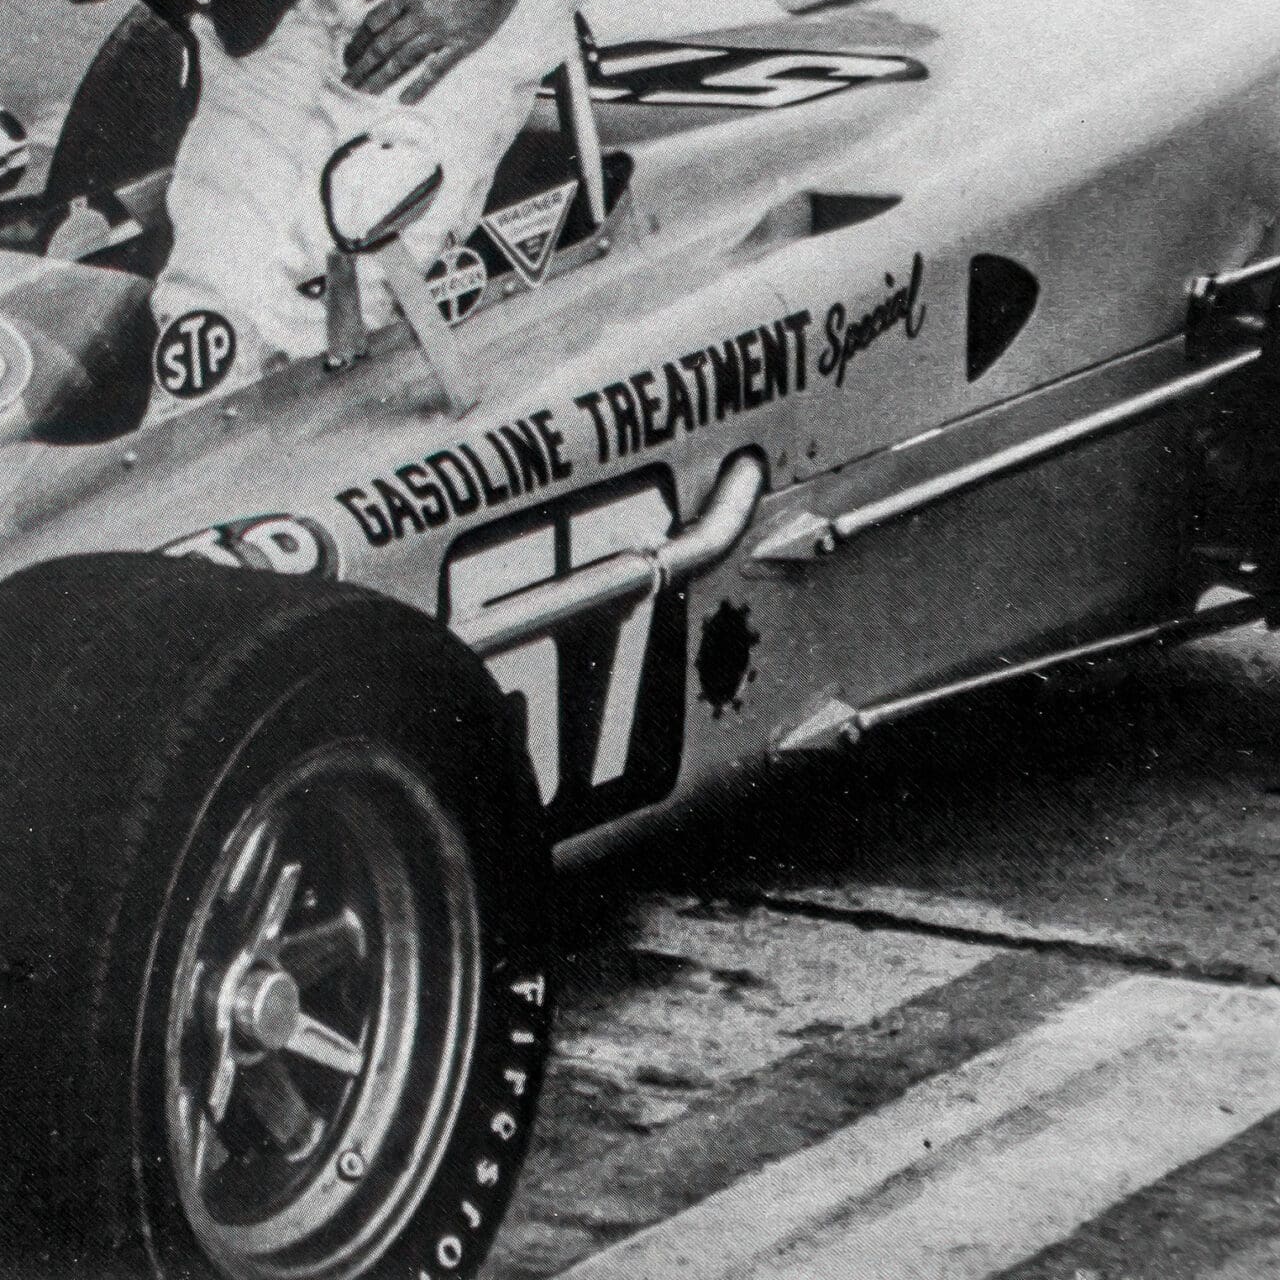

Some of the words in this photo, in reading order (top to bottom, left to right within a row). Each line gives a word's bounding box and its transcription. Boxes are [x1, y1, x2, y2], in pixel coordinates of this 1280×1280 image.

[163, 315, 230, 390] STP
[334, 409, 573, 547] GASOLINE
[574, 309, 813, 464] TREATMENT
[818, 251, 926, 389] Special
[163, 520, 318, 574] TP
